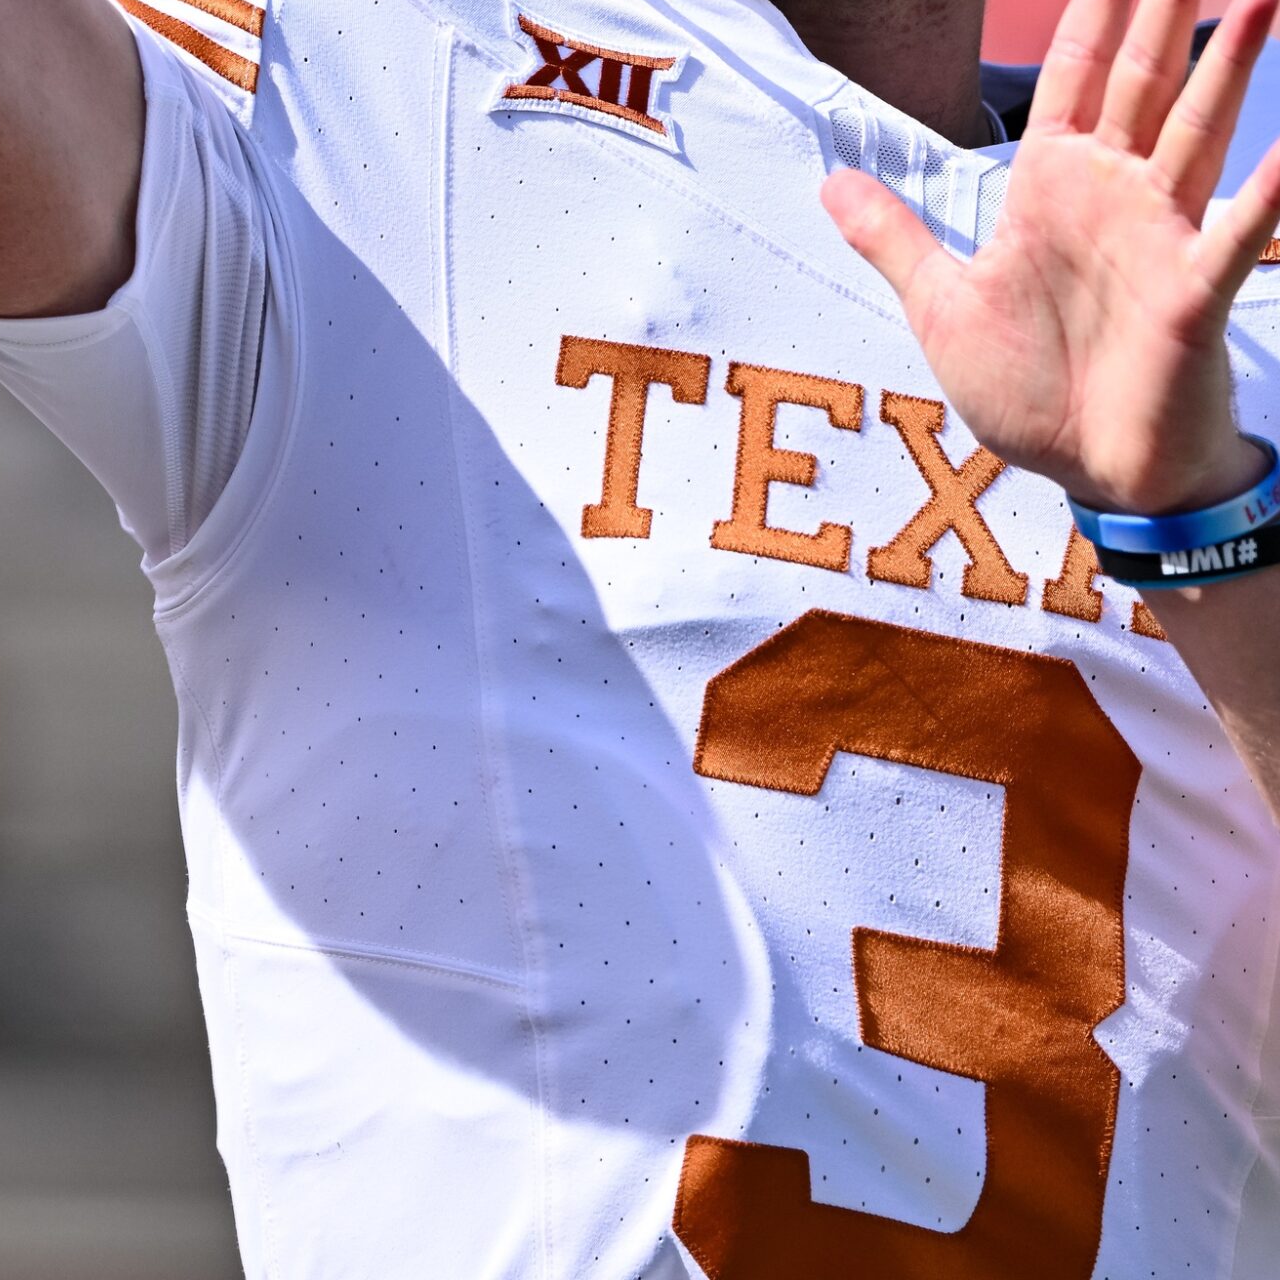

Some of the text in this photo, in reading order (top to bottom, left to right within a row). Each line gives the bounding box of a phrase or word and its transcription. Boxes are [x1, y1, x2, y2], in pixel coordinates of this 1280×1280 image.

[501, 13, 677, 137] XII
[555, 334, 1168, 642] TEX
[672, 608, 1143, 1280] 3
